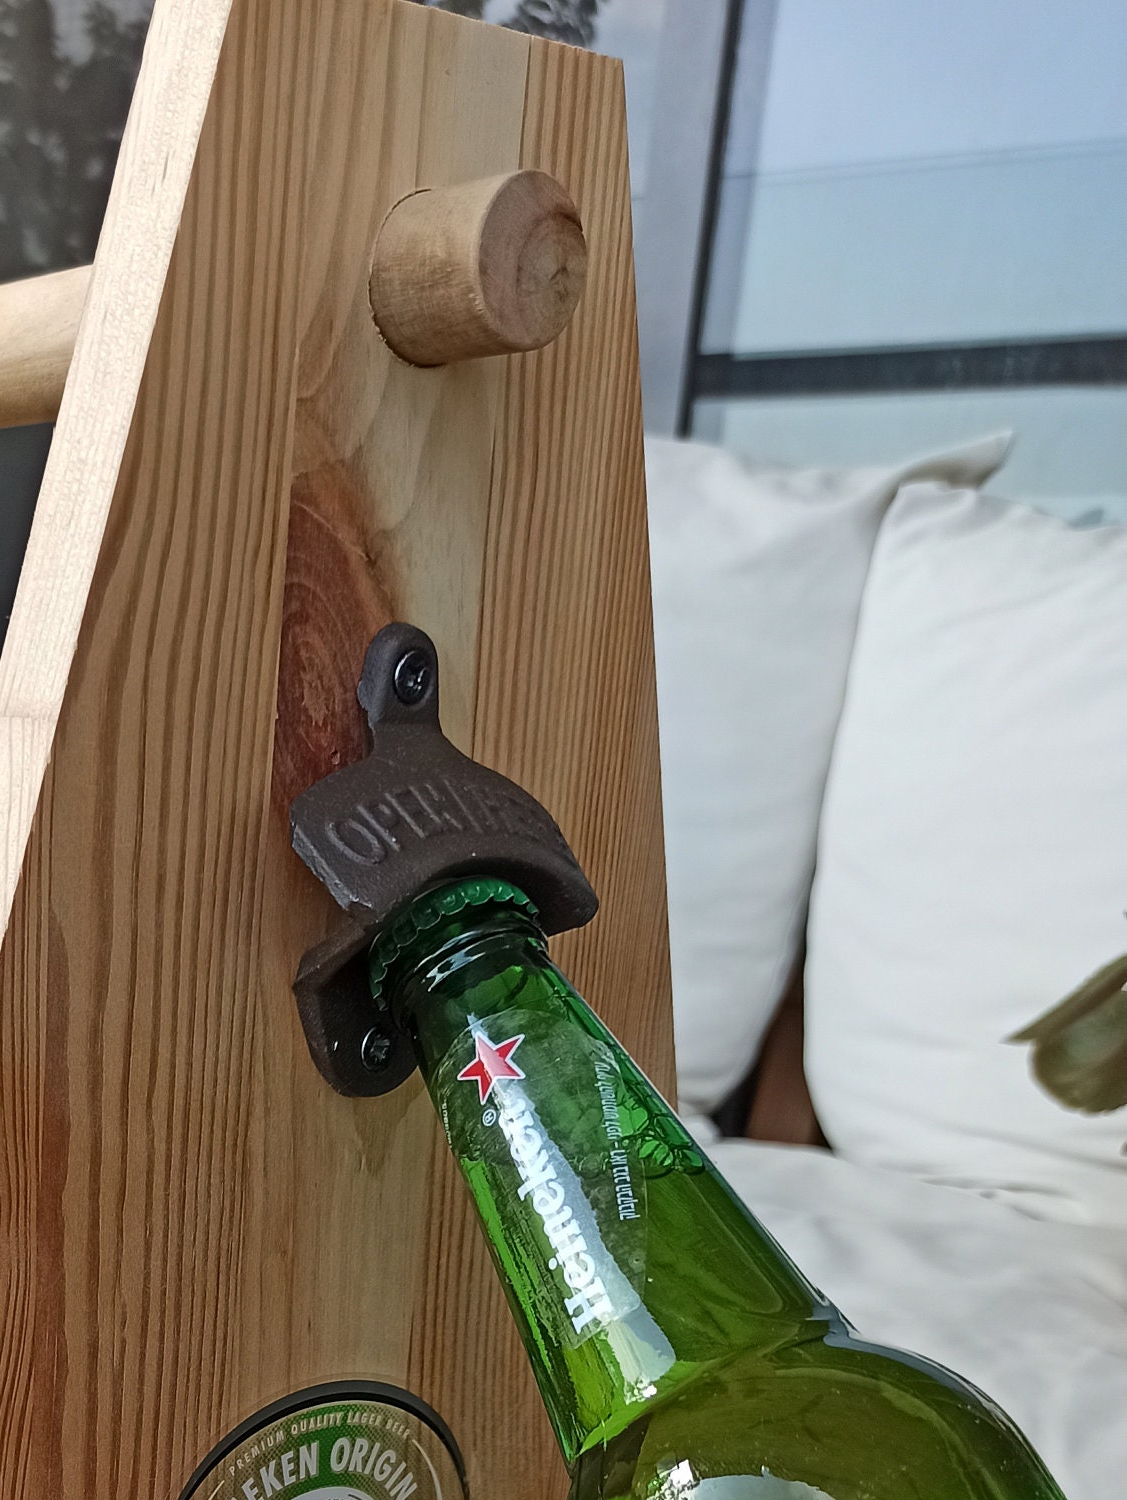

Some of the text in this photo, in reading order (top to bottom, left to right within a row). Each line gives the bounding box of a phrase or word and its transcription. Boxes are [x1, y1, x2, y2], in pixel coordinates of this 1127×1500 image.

[229, 1411, 411, 1476] PREMIUM QUALITY LAGER BEER
